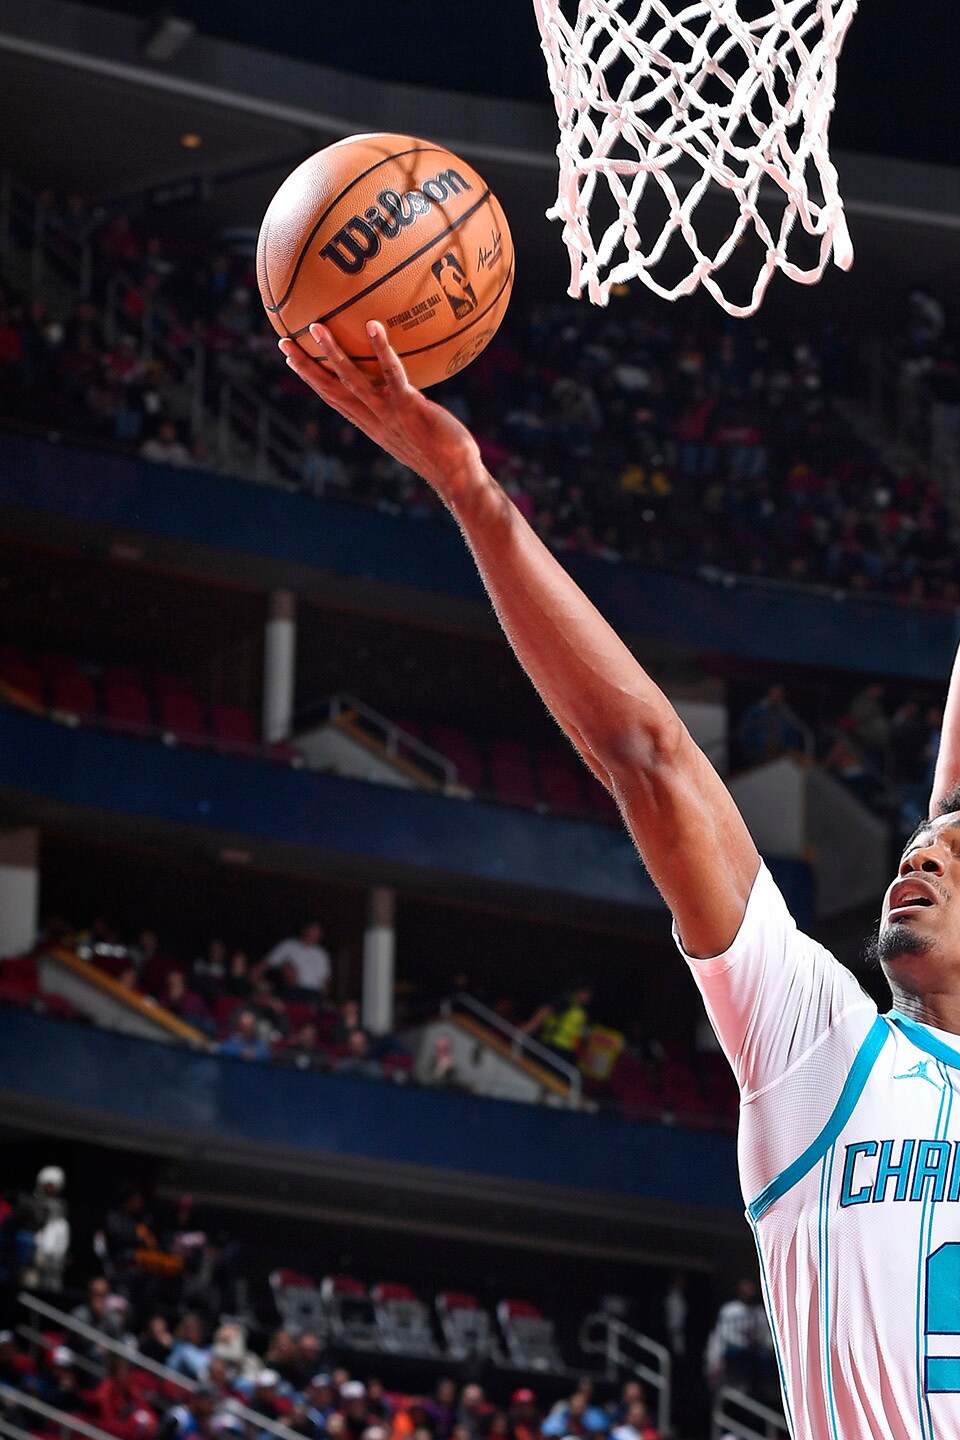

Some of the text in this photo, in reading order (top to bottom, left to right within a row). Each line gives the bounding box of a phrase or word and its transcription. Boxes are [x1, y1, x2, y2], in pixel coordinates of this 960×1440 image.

[318, 169, 473, 275] Wilson
[386, 310, 413, 328] OFFICIAL
[411, 301, 429, 317] GAME
